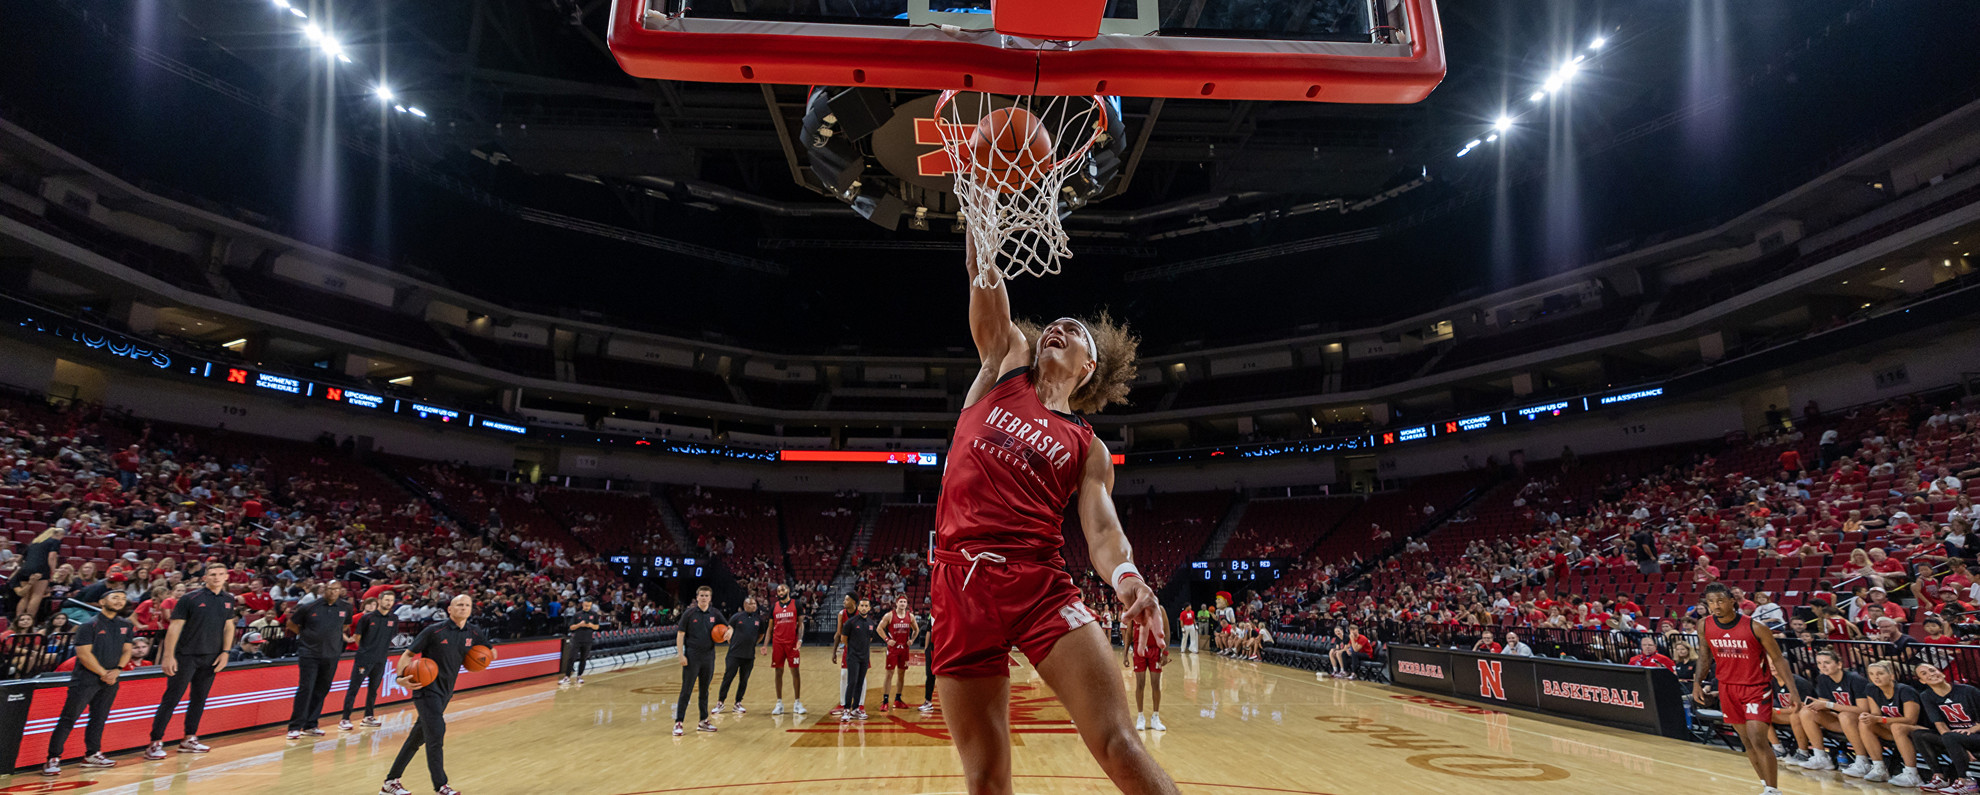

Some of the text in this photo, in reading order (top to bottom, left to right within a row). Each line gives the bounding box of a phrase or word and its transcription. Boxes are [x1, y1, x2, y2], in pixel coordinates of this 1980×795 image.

[227, 368, 248, 384] N
[259, 373, 300, 387] WOMEN'S
[256, 380, 300, 394] SCHEDULE
[326, 387, 343, 401] N
[344, 390, 384, 404] UPCOMING
[1601, 388, 1663, 404] FAN ASSISTANCE
[348, 398, 378, 408] EVENTS
[223, 405, 247, 416] 109
[412, 404, 439, 415] FOLLOW
[1519, 404, 1547, 416] FOLLOW
[1458, 415, 1491, 427] UPCOMING
[1463, 421, 1488, 431] EVENTS
[494, 422, 527, 434] ASSISTANCE
[1400, 426, 1426, 437] WOMEN'S
[1446, 422, 1457, 433] N
[1623, 424, 1646, 434] 115
[985, 406, 1072, 470] NEBRASKA
[1383, 433, 1394, 445] N
[1400, 432, 1427, 442] SCHEDULE
[1259, 560, 1271, 568] RED
[695, 567, 703, 577] 0
[1204, 569, 1211, 580] 0
[1058, 600, 1097, 632] N
[1838, 624, 1845, 635] 1
[1398, 660, 1444, 680] NEBRASKA
[1478, 659, 1507, 700] N
[1542, 679, 1645, 709] BASKETBALL
[1832, 691, 1851, 706] N
[1745, 702, 1759, 714] N
[1938, 703, 1971, 722] N
